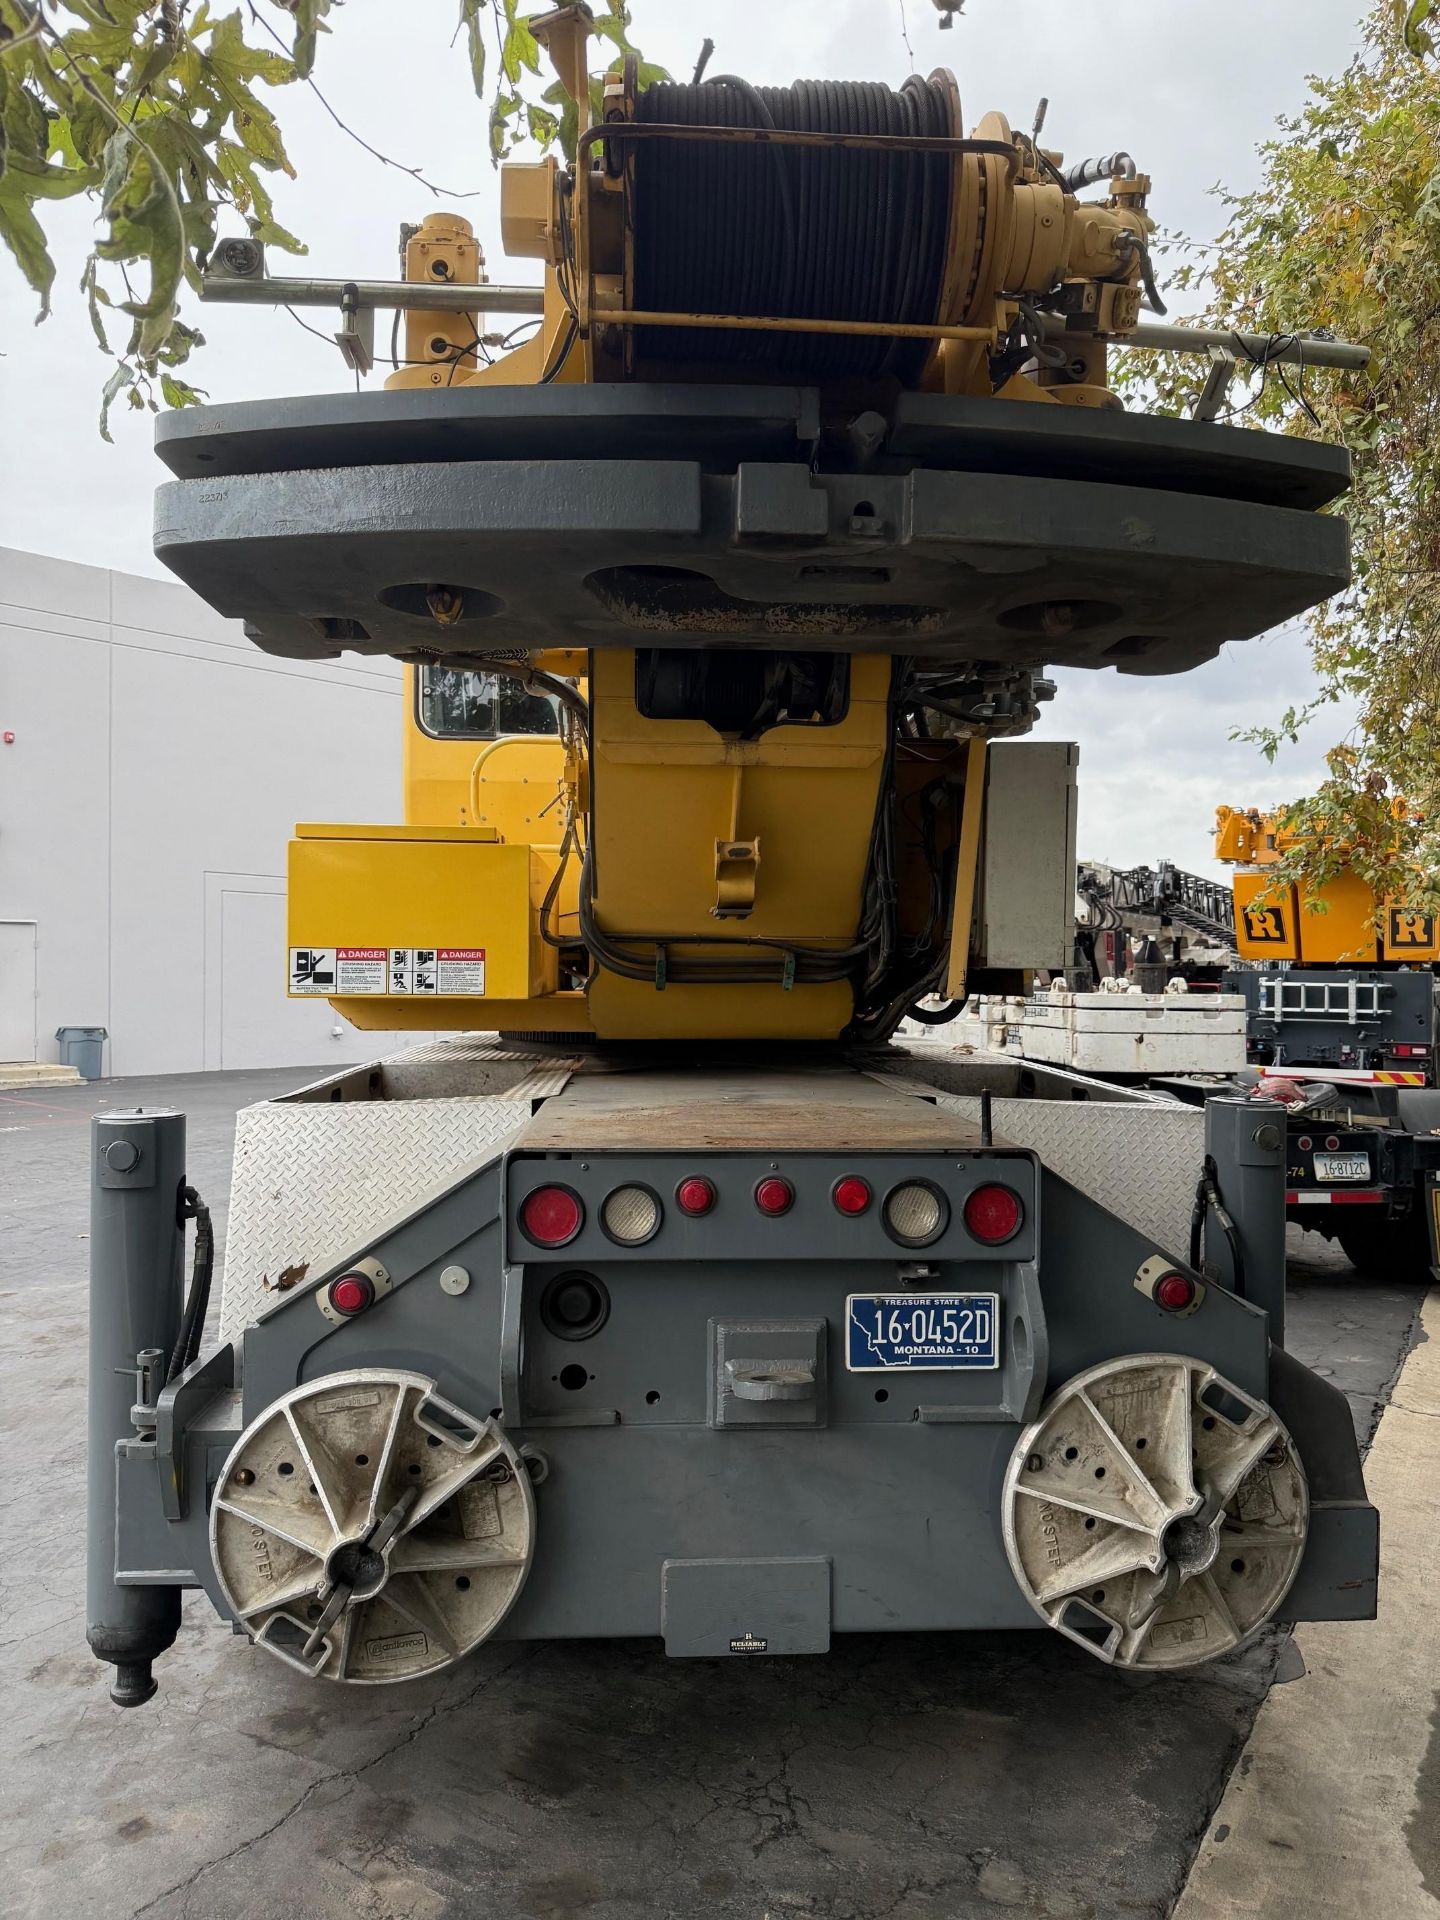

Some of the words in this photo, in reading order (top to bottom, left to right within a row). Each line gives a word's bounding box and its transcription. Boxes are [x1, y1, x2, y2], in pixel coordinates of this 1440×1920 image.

[1248, 911, 1281, 938] R
[1396, 912, 1428, 943] R
[1286, 1167, 1305, 1176] -74
[894, 1345, 954, 1354] MONTANA
[965, 1346, 979, 1354] 10
[253, 1540, 272, 1580] STEP
[1043, 1526, 1061, 1567] STEP
